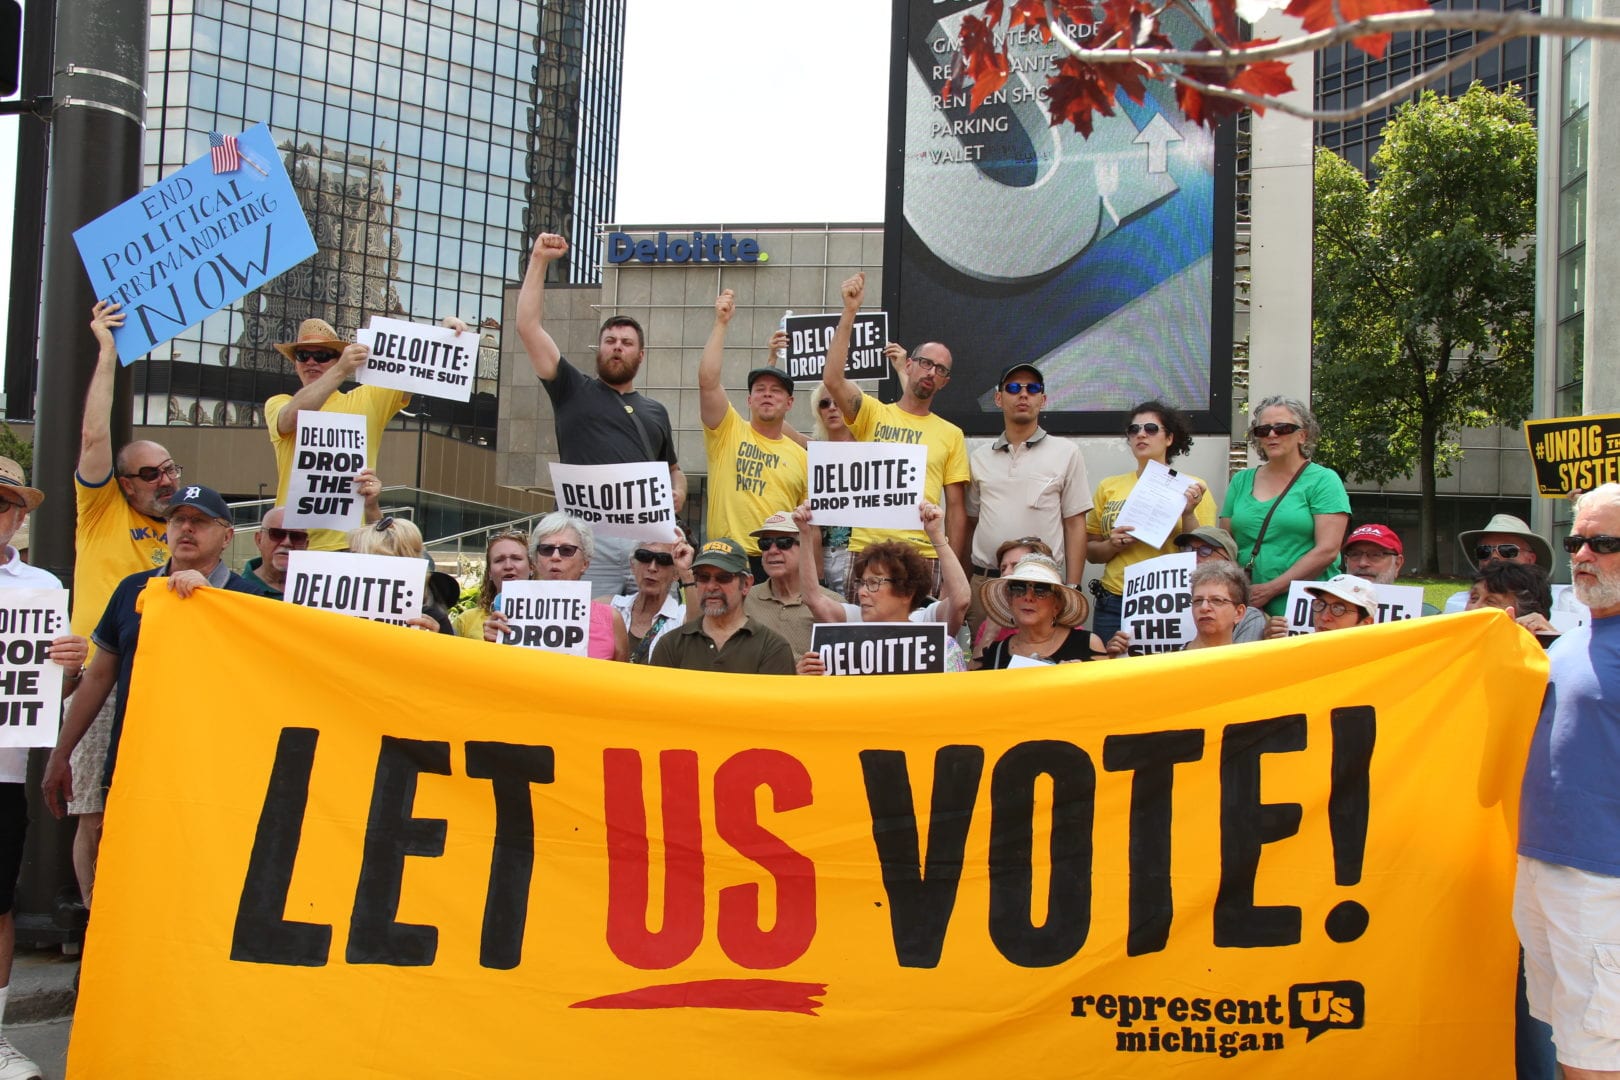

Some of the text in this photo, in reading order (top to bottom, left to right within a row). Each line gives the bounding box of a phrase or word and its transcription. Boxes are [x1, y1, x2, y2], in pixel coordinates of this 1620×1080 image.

[931, 117, 1008, 138] PARKING
[930, 145, 984, 163] VALET
[140, 177, 194, 221] END
[101, 179, 253, 282] POLITICAL
[134, 222, 273, 346] NOW
[372, 331, 469, 371] DELOITTE:
[792, 321, 881, 355] DELOTE:
[367, 358, 469, 386] DROP THE SUIT
[790, 355, 826, 377] DROP
[852, 347, 883, 370] SUIT
[301, 426, 364, 449] DELOITTE:
[874, 421, 923, 445] COUNTRY
[1535, 425, 1602, 463] #UNRIG
[297, 450, 364, 472] DROP
[1559, 456, 1620, 492] SYSTE
[307, 474, 354, 494] THE
[813, 458, 917, 495] DELOITTE:
[297, 496, 354, 516] SUIT
[562, 476, 666, 511] DELOITTE:
[810, 492, 918, 511] DROP THE SUIT
[605, 513, 635, 525] THE
[637, 508, 671, 525] SUIT
[293, 572, 413, 615] DELOITTE:
[1123, 592, 1193, 619] DROP
[504, 597, 586, 621] DELOITTE:
[502, 624, 584, 648] DROP
[1130, 618, 1182, 640] THE
[820, 635, 936, 676] DELOITTE:
[229, 704, 1377, 971] LET US VOTE!
[1070, 993, 1284, 1028] represent
[1115, 1026, 1285, 1059] michigan
